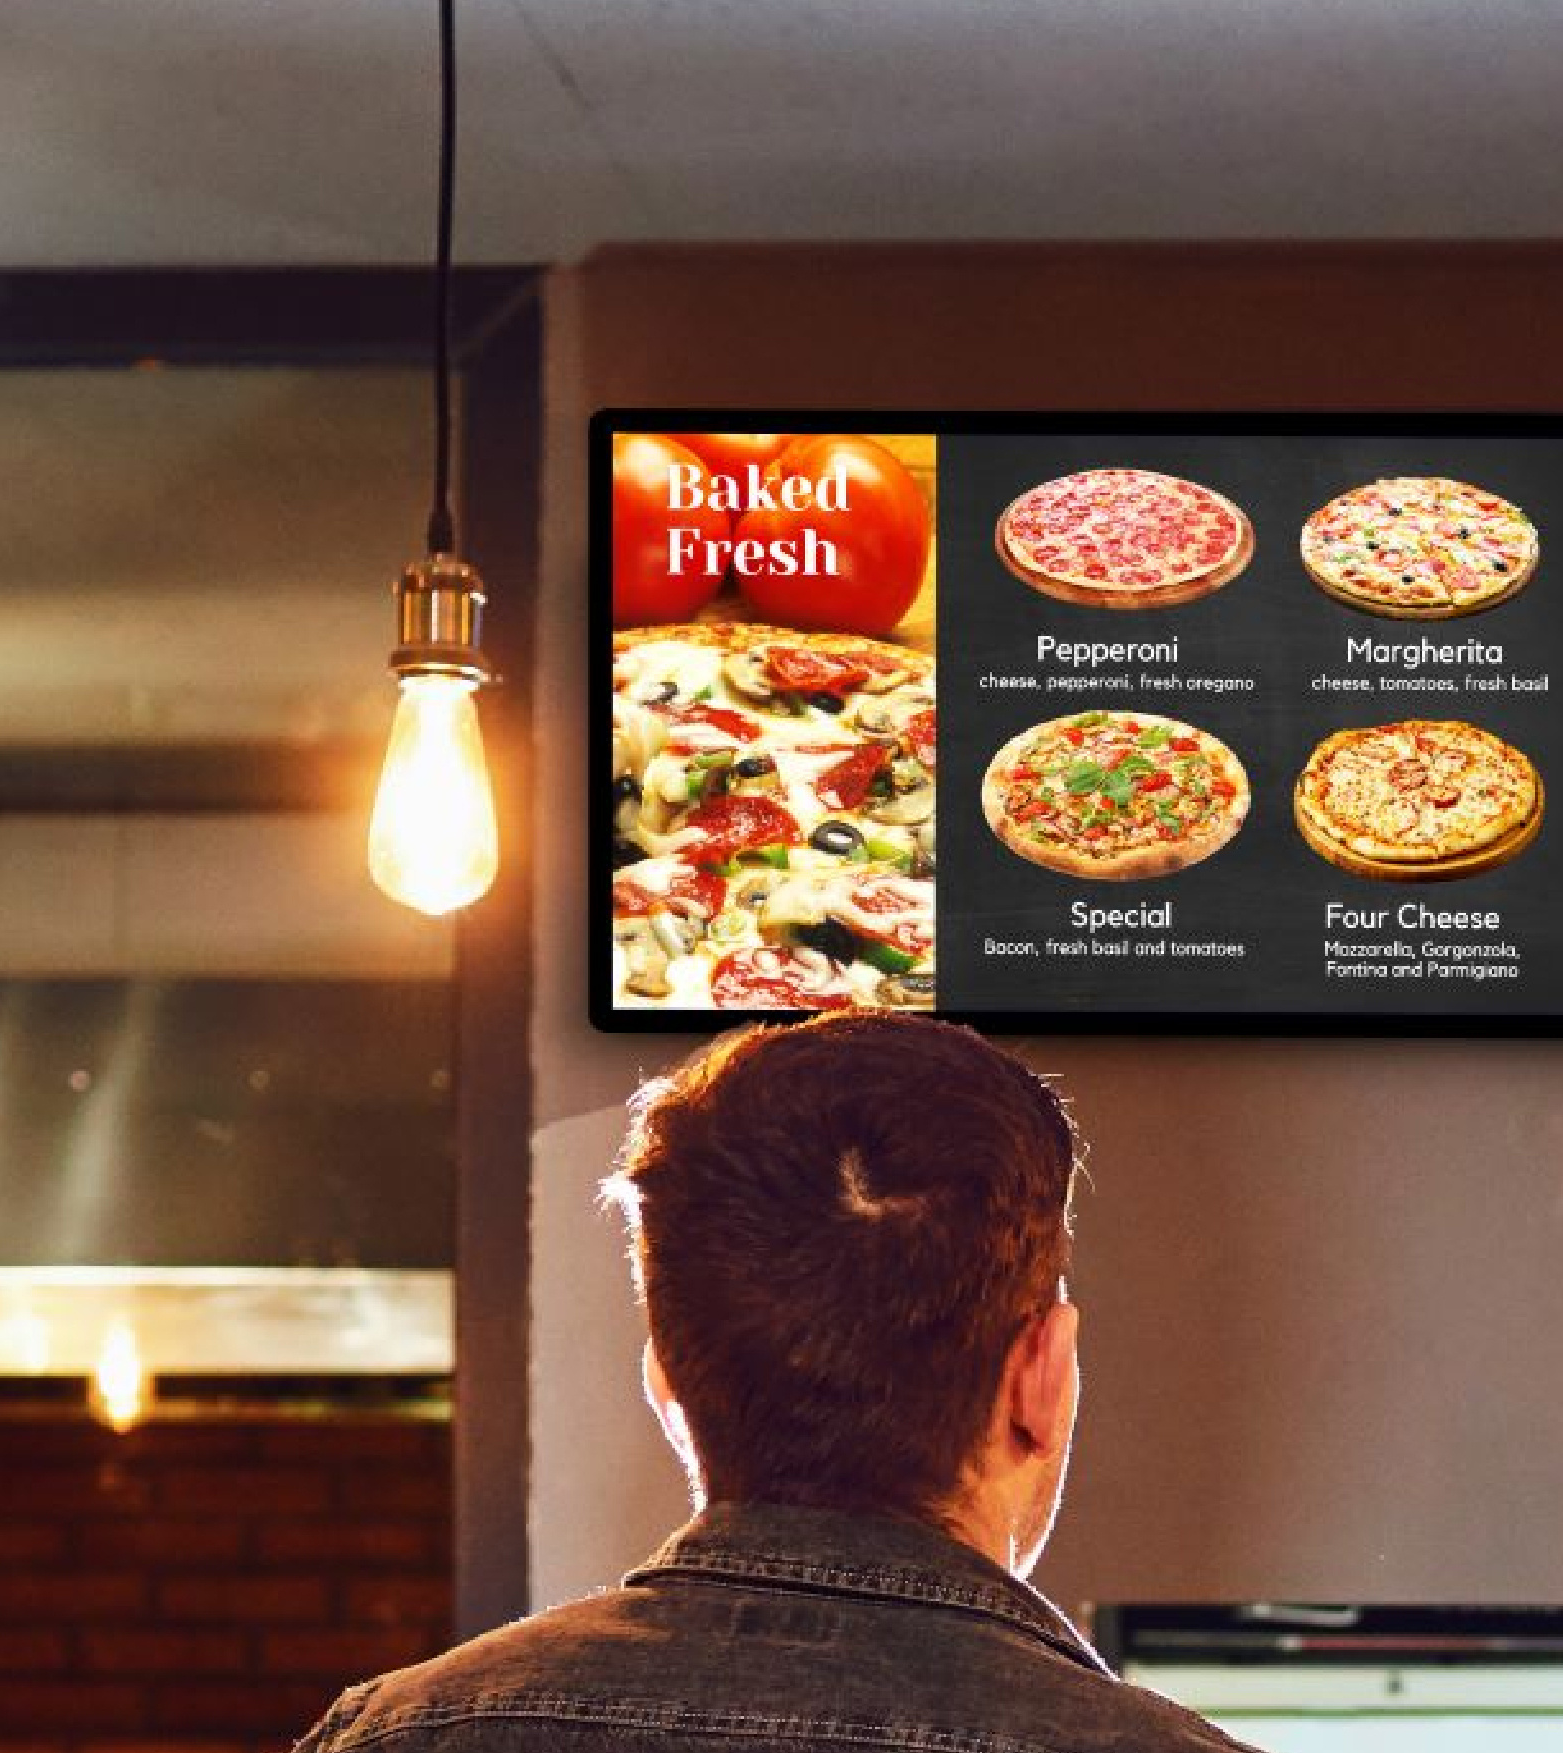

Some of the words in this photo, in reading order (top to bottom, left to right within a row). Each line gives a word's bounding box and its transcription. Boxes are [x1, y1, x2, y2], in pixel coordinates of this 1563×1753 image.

[667, 463, 849, 512] Baked
[667, 527, 839, 576] Fresh
[1038, 636, 1177, 667] Pepperoni
[1348, 636, 1502, 669] Margherita
[980, 672, 1041, 690] cheese,
[1046, 674, 1133, 692] pepperoni,
[1141, 674, 1182, 690] fresh
[1187, 680, 1253, 692] oregano
[1312, 674, 1374, 690] cheese,
[1379, 677, 1458, 692] tomatoes,
[1466, 674, 1507, 690] fresh
[1512, 674, 1548, 690] basil
[1072, 902, 1172, 933] Special
[1325, 902, 1389, 928] Four
[1397, 902, 1499, 930] Cheese
[985, 938, 1038, 956] Bacon,
[1046, 938, 1087, 954] fresh
[1092, 941, 1128, 956] basil
[1136, 941, 1164, 956] and
[1172, 941, 1246, 956] tomatoes
[1325, 941, 1415, 959] Mozzarella,
[1422, 941, 1520, 959] Gorgonzola,
[1328, 961, 1387, 977] Fontina
[1392, 961, 1422, 977] and
[1428, 961, 1517, 979] Parmigiano
